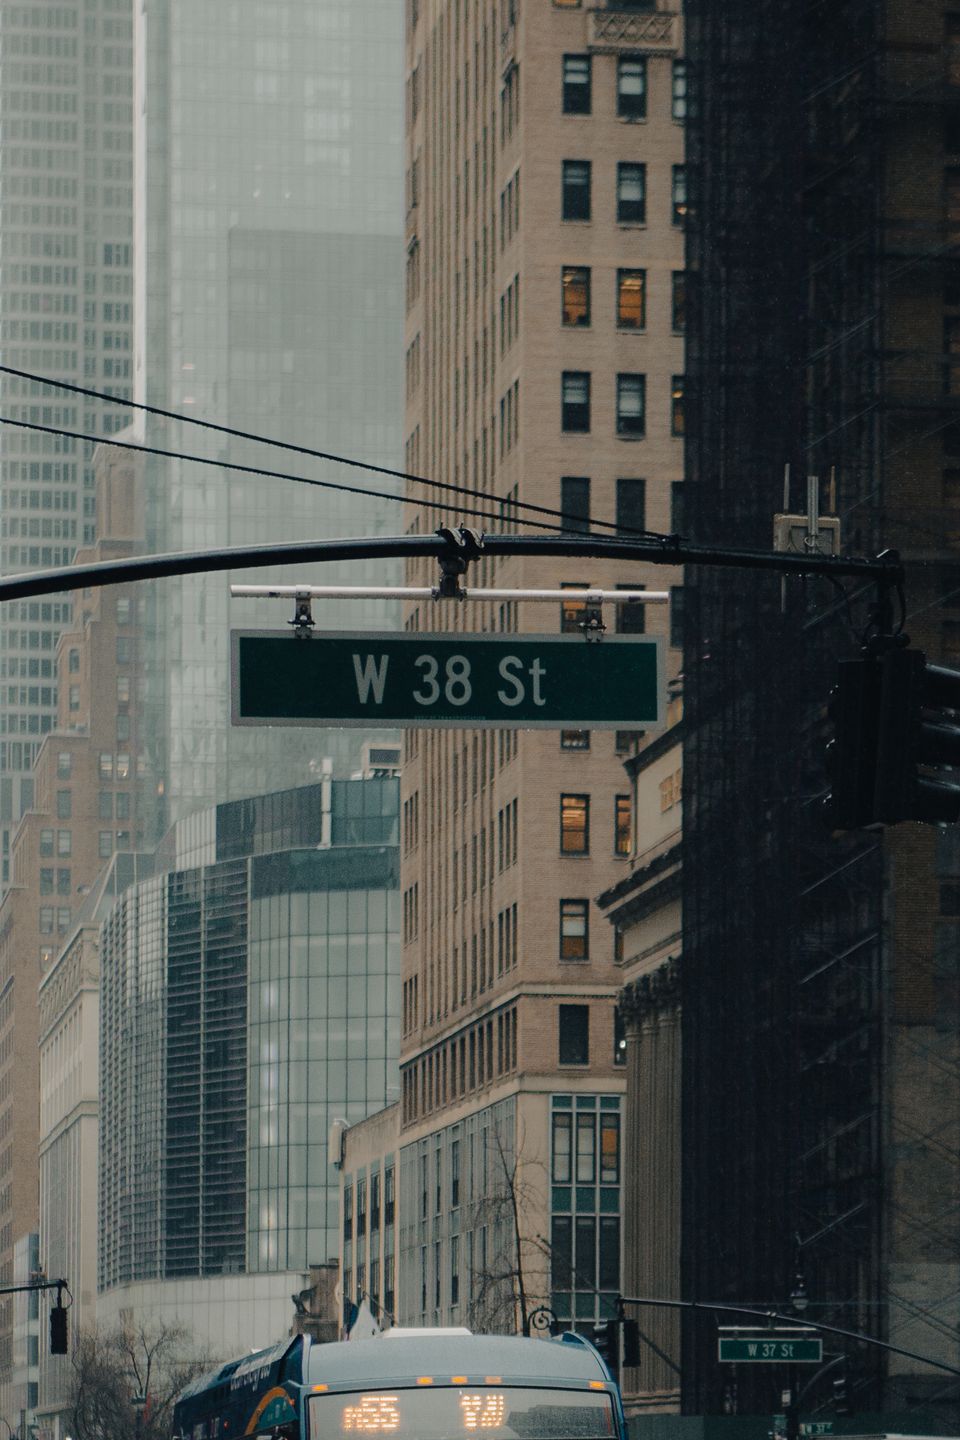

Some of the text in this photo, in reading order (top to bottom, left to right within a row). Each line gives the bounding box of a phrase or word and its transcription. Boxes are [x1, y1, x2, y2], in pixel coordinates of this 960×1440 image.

[352, 654, 547, 707] W 38 St
[748, 1344, 794, 1357] W 37 St
